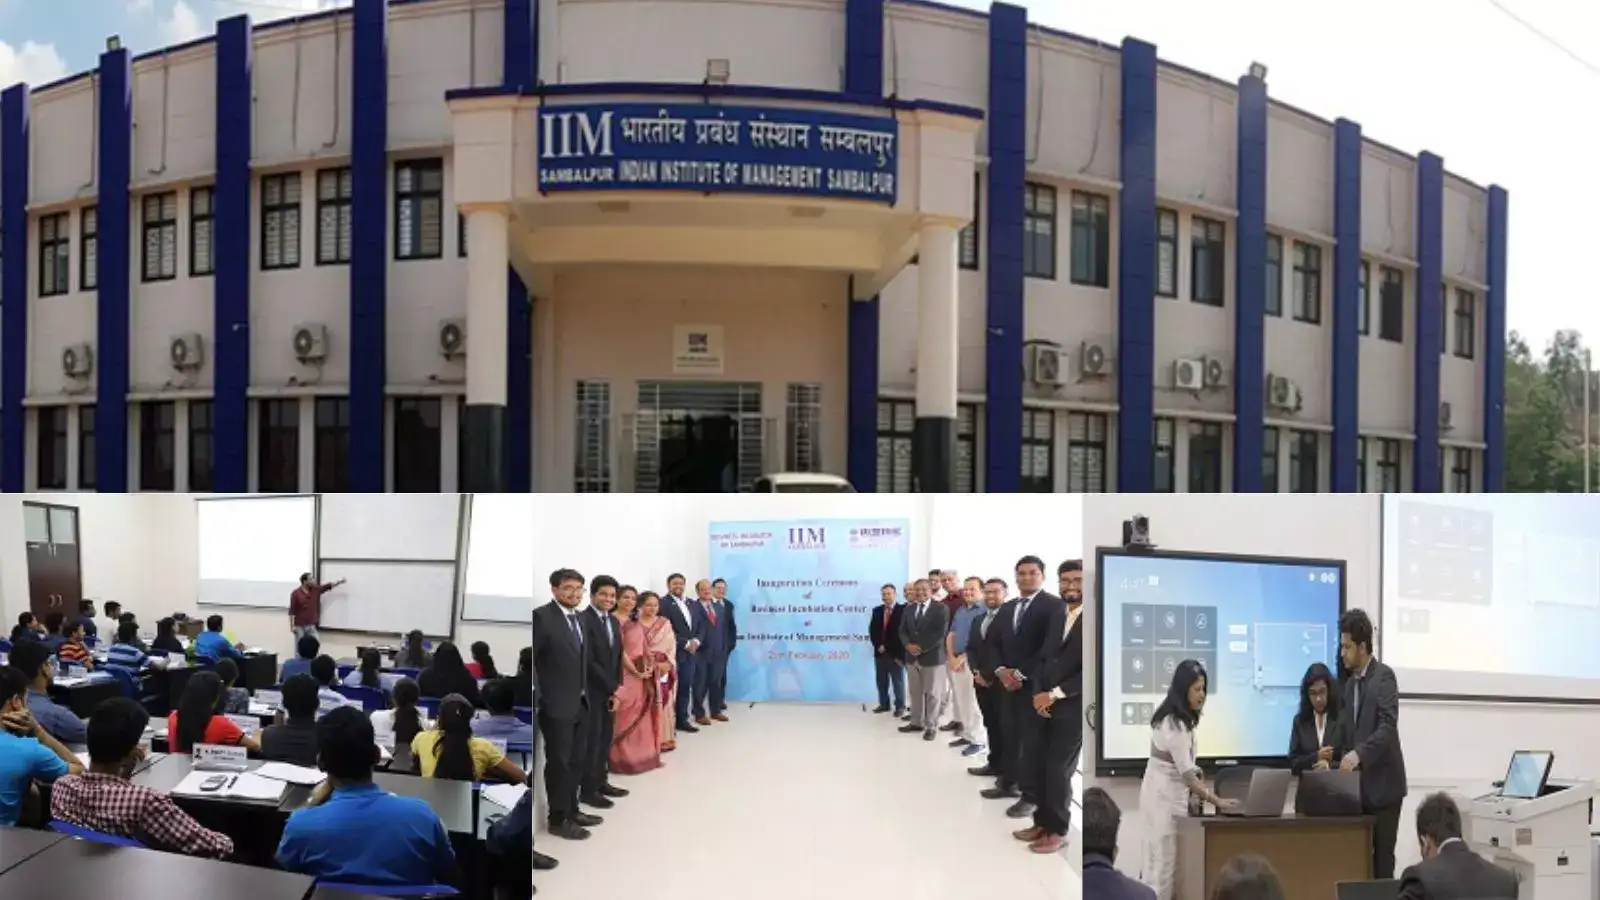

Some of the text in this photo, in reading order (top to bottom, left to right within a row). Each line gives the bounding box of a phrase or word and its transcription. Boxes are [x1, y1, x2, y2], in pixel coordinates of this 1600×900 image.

[541, 111, 614, 158] IIM
[620, 108, 687, 144] भारतीय
[694, 111, 740, 145] प्रबंध
[748, 113, 811, 149] संस्थान
[540, 167, 615, 183] SAMBALPUR
[618, 160, 894, 195] INDIAN INSTITUTE OF MANAGEMENT SAMBALPUR
[788, 527, 825, 544] IIM
